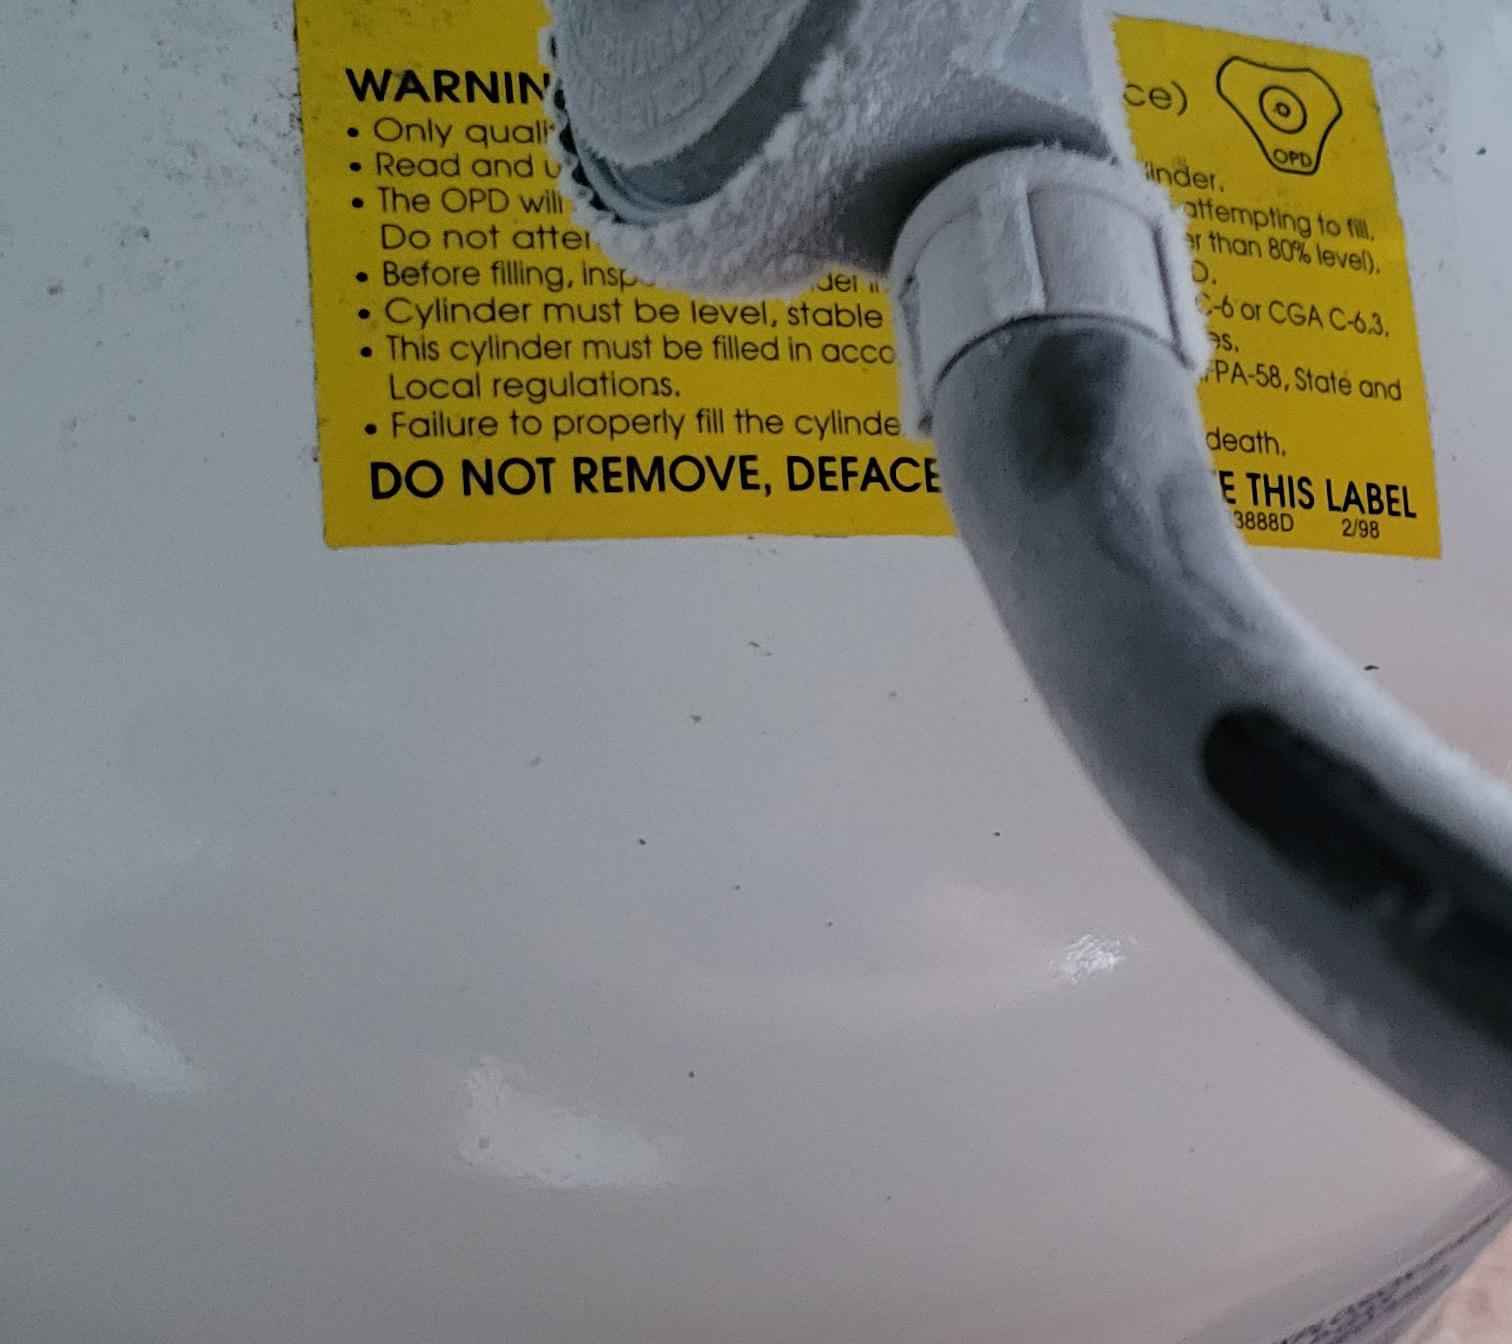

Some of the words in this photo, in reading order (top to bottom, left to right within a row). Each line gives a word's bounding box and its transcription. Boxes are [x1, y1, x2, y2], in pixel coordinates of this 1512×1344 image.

[345, 68, 550, 104] WARNIN
[374, 117, 452, 147] Only
[466, 120, 556, 149] quali
[1145, 161, 1225, 192] inder.
[1273, 148, 1312, 167] OPD
[376, 152, 460, 178] Read
[471, 154, 534, 178] and
[1184, 198, 1312, 239] attempting
[1318, 214, 1341, 237] to
[1347, 218, 1375, 241] fill.
[378, 187, 430, 213] The
[441, 187, 509, 214] OPD
[1208, 232, 1262, 258] than
[1268, 237, 1312, 264] 80%
[1317, 244, 1381, 275] level).
[381, 224, 431, 250] Do
[443, 223, 499, 249] not
[512, 225, 592, 251] atte
[384, 260, 480, 288] Before
[491, 261, 573, 293] filling,
[1241, 302, 1262, 321] or
[1268, 300, 1323, 329] CGA
[1329, 307, 1390, 338] C-6.3.
[385, 297, 530, 330] Cylinder
[543, 298, 622, 323] must
[635, 297, 680, 324] be
[691, 299, 777, 328] level,
[787, 302, 883, 328] stable
[386, 334, 440, 362] This
[450, 333, 571, 366] cylinder
[583, 335, 651, 360] must
[663, 335, 702, 360] be
[713, 335, 780, 361] filled
[789, 335, 812, 361] in
[1203, 359, 1290, 392] PA-58,
[1294, 367, 1353, 396] State
[1359, 378, 1402, 401] and
[389, 371, 481, 400] Local
[493, 370, 680, 404] regulations.
[391, 410, 498, 439] Failure
[509, 408, 542, 436] to
[554, 408, 685, 443] properly
[697, 408, 725, 435] fill
[734, 408, 784, 435] the
[795, 409, 901, 441] cylinde
[1205, 427, 1286, 457] death.
[370, 461, 444, 500] DO
[461, 456, 556, 497] NOT
[573, 454, 772, 497] REMOVE,
[787, 455, 943, 494] DEFACE
[1246, 472, 1315, 510] THIS
[1325, 478, 1417, 518] LABEL
[1341, 518, 1380, 539] 2/98
